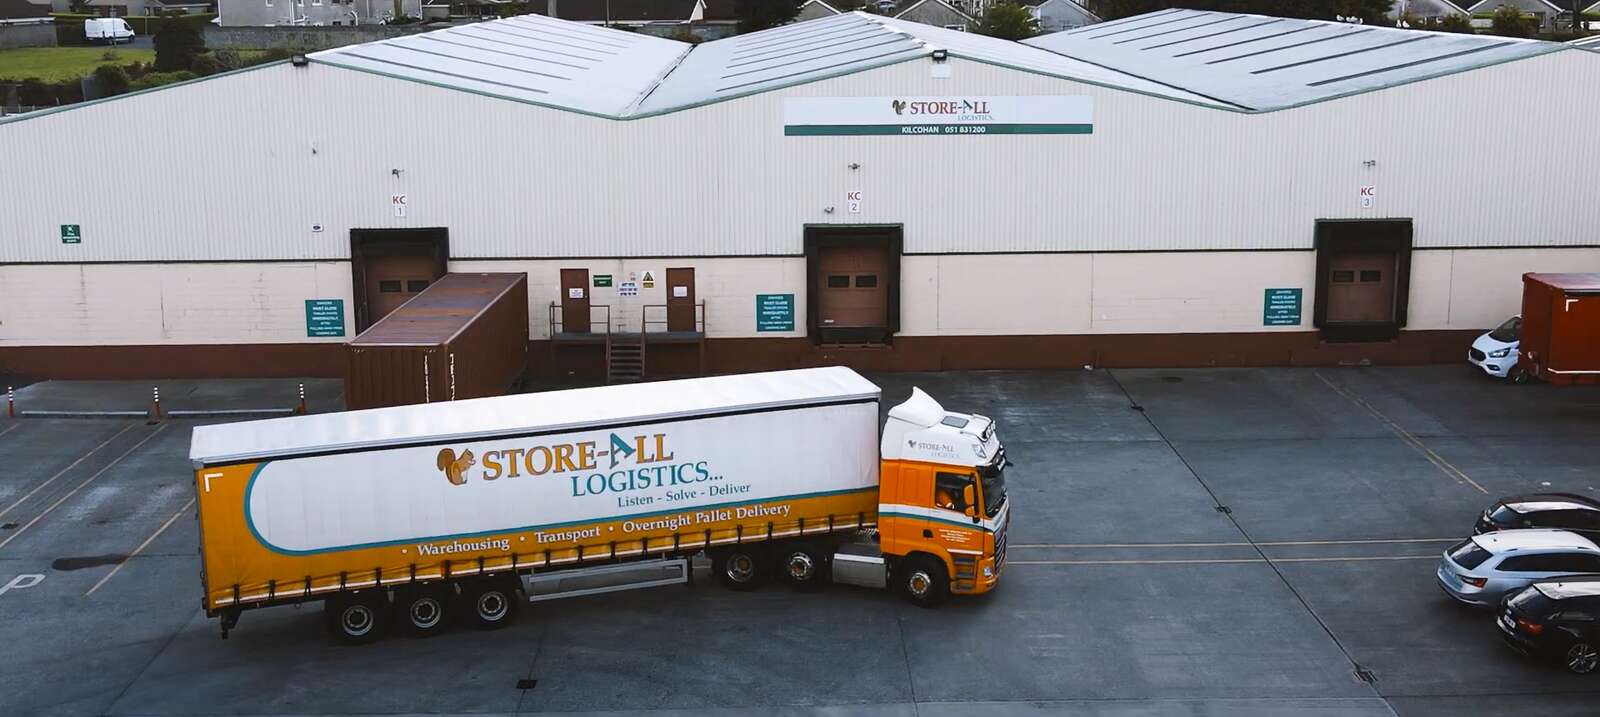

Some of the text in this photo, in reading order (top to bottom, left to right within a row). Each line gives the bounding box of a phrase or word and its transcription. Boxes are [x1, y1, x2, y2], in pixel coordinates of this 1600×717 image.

[910, 100, 990, 114] STORE-ALL
[848, 191, 861, 201] KC
[1360, 187, 1374, 196] KC
[392, 195, 406, 204] KC
[1364, 198, 1370, 206] 3
[851, 202, 857, 211] 2
[482, 432, 674, 481] STORE-ALL
[618, 496, 654, 508] Listen
[666, 489, 697, 502] Solve
[709, 484, 751, 497] Deliver
[416, 504, 791, 556] Warehousing Transport Overnight Pallet Delivery
